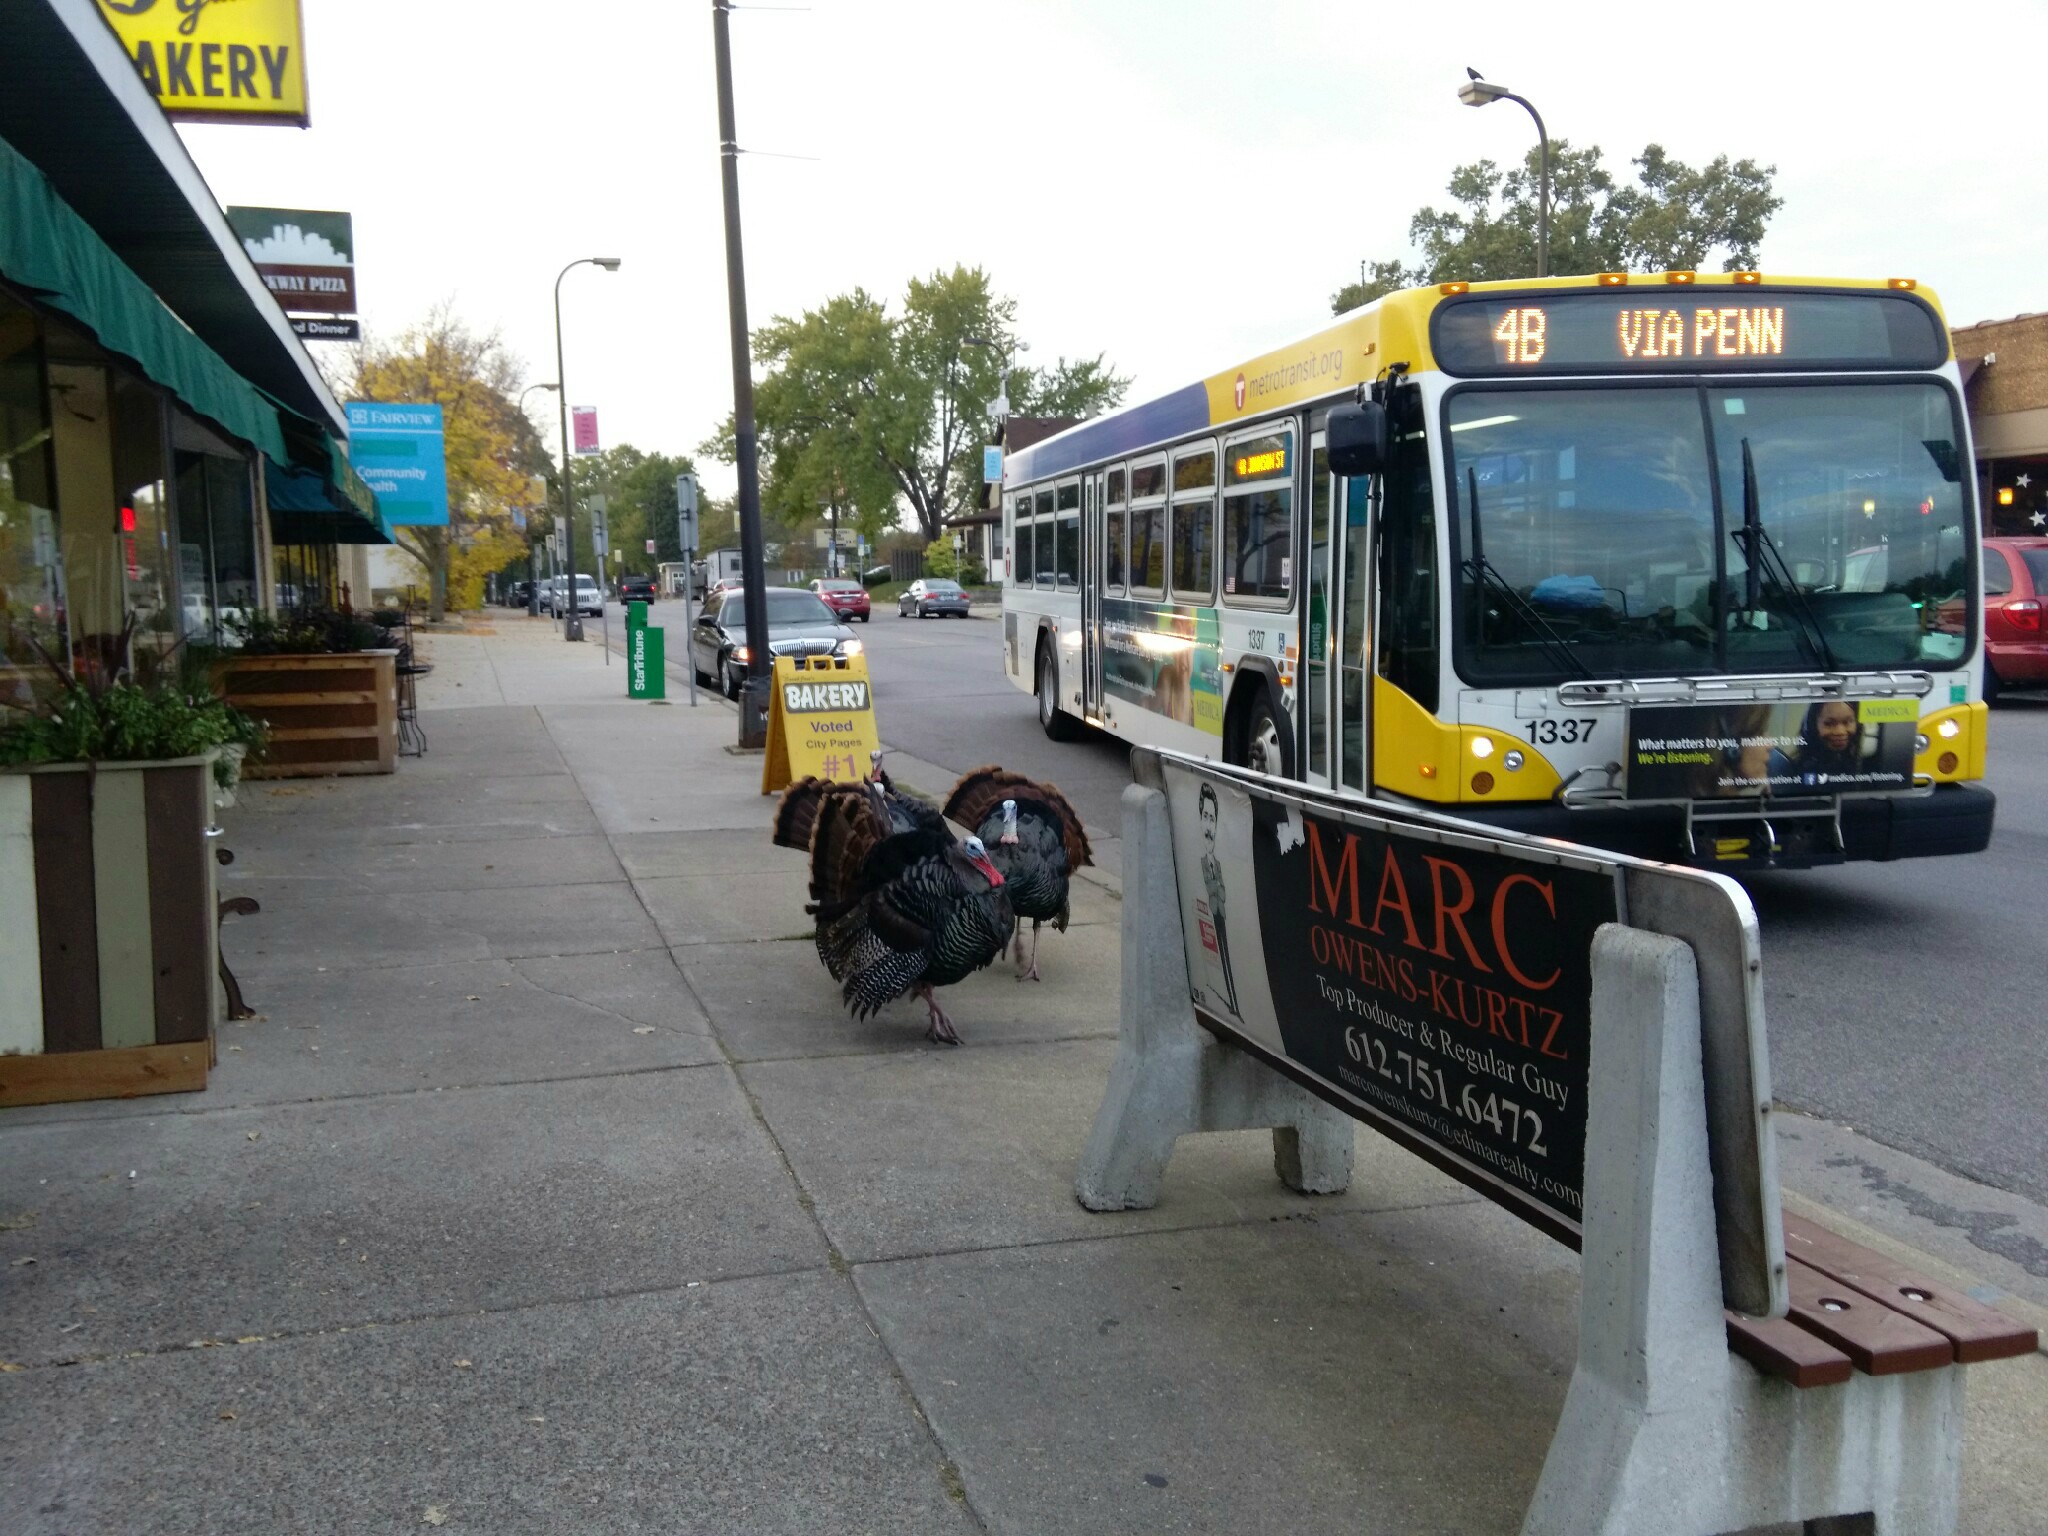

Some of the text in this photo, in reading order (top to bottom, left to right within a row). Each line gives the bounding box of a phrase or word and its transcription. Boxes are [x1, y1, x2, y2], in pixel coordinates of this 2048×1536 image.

[133, 40, 289, 99] AKERY
[308, 277, 347, 292] PIZZA
[292, 322, 350, 335] nd Dinner
[1495, 307, 1784, 363] 4B VIA PENN
[1249, 349, 1343, 398] metrotransit.org
[356, 466, 427, 480] Community
[367, 480, 398, 492] ealth
[1248, 629, 1266, 651] 1337
[634, 629, 645, 691] StarTribune
[785, 683, 866, 710] BAKERY
[810, 720, 854, 734] Voted
[1525, 719, 1597, 744] 1337
[806, 739, 862, 750] City Pages
[1638, 736, 1808, 750] What matters to you, matters to us.
[822, 753, 857, 779] #1
[1637, 752, 1714, 764] We're listening.
[1304, 819, 1562, 991] MARC
[1311, 925, 1568, 1060] OWENS-KURTZ
[1316, 974, 1569, 1112] Top Producer & Regular Guy
[1345, 1025, 1548, 1158] 612.751.6472
[1338, 1064, 1583, 1209] marcowenskurtz@edinarealty.com
